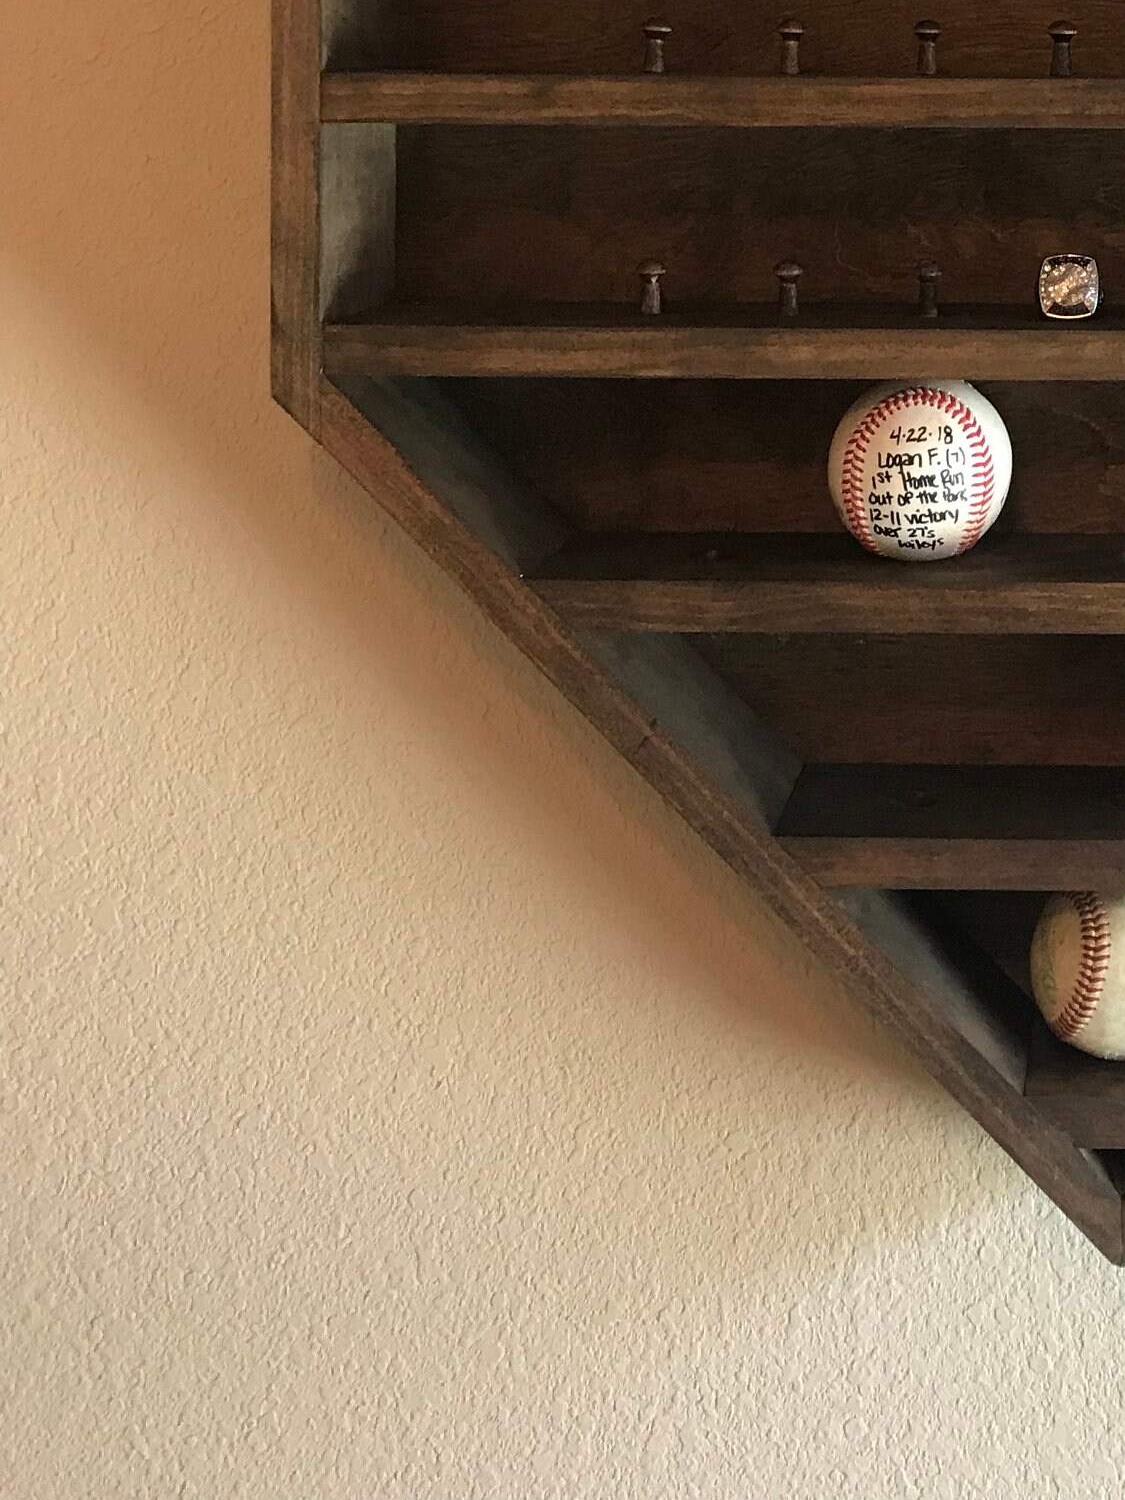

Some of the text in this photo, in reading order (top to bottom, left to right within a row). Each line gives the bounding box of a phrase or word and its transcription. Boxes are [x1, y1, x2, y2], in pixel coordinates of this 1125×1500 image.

[877, 451, 923, 474] Logan
[901, 471, 939, 491] Home
[940, 469, 964, 490] Run
[916, 489, 938, 505] the
[869, 508, 959, 525] 12-11 victory
